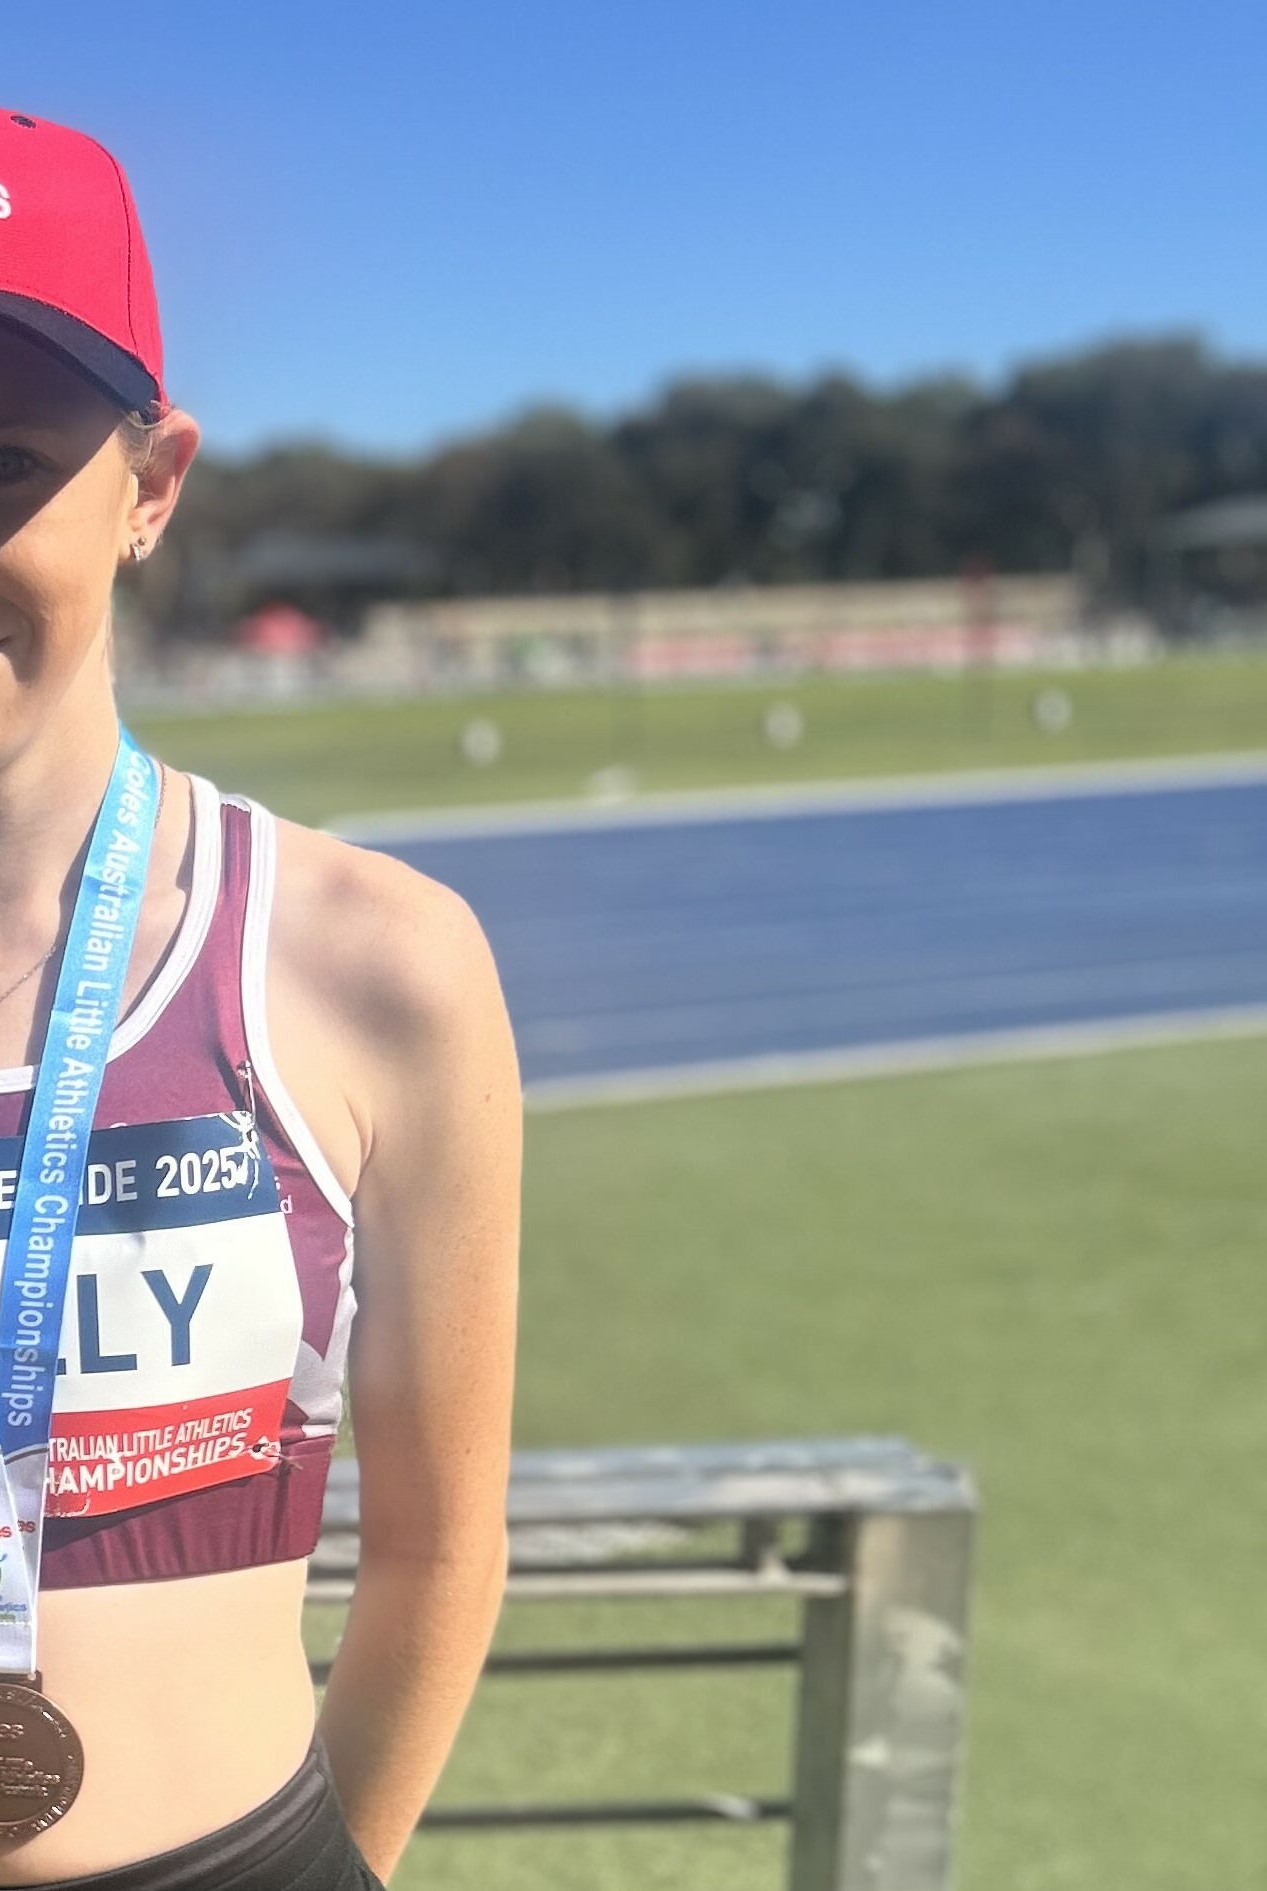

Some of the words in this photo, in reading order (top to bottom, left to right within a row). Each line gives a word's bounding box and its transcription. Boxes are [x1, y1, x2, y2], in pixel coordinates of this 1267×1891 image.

[117, 751, 152, 827] Coles
[82, 828, 141, 972] Australian
[66, 980, 112, 1050] Little
[39, 1056, 94, 1185] Athletics
[155, 1147, 239, 1198] 2025
[1, 1194, 69, 1428] Championships
[47, 1432, 247, 1494] HAMPIONSHIPS
[48, 1434, 118, 1462] TRALIAN
[123, 1425, 174, 1457] LITTLE
[175, 1408, 253, 1444] ATHLETICS
